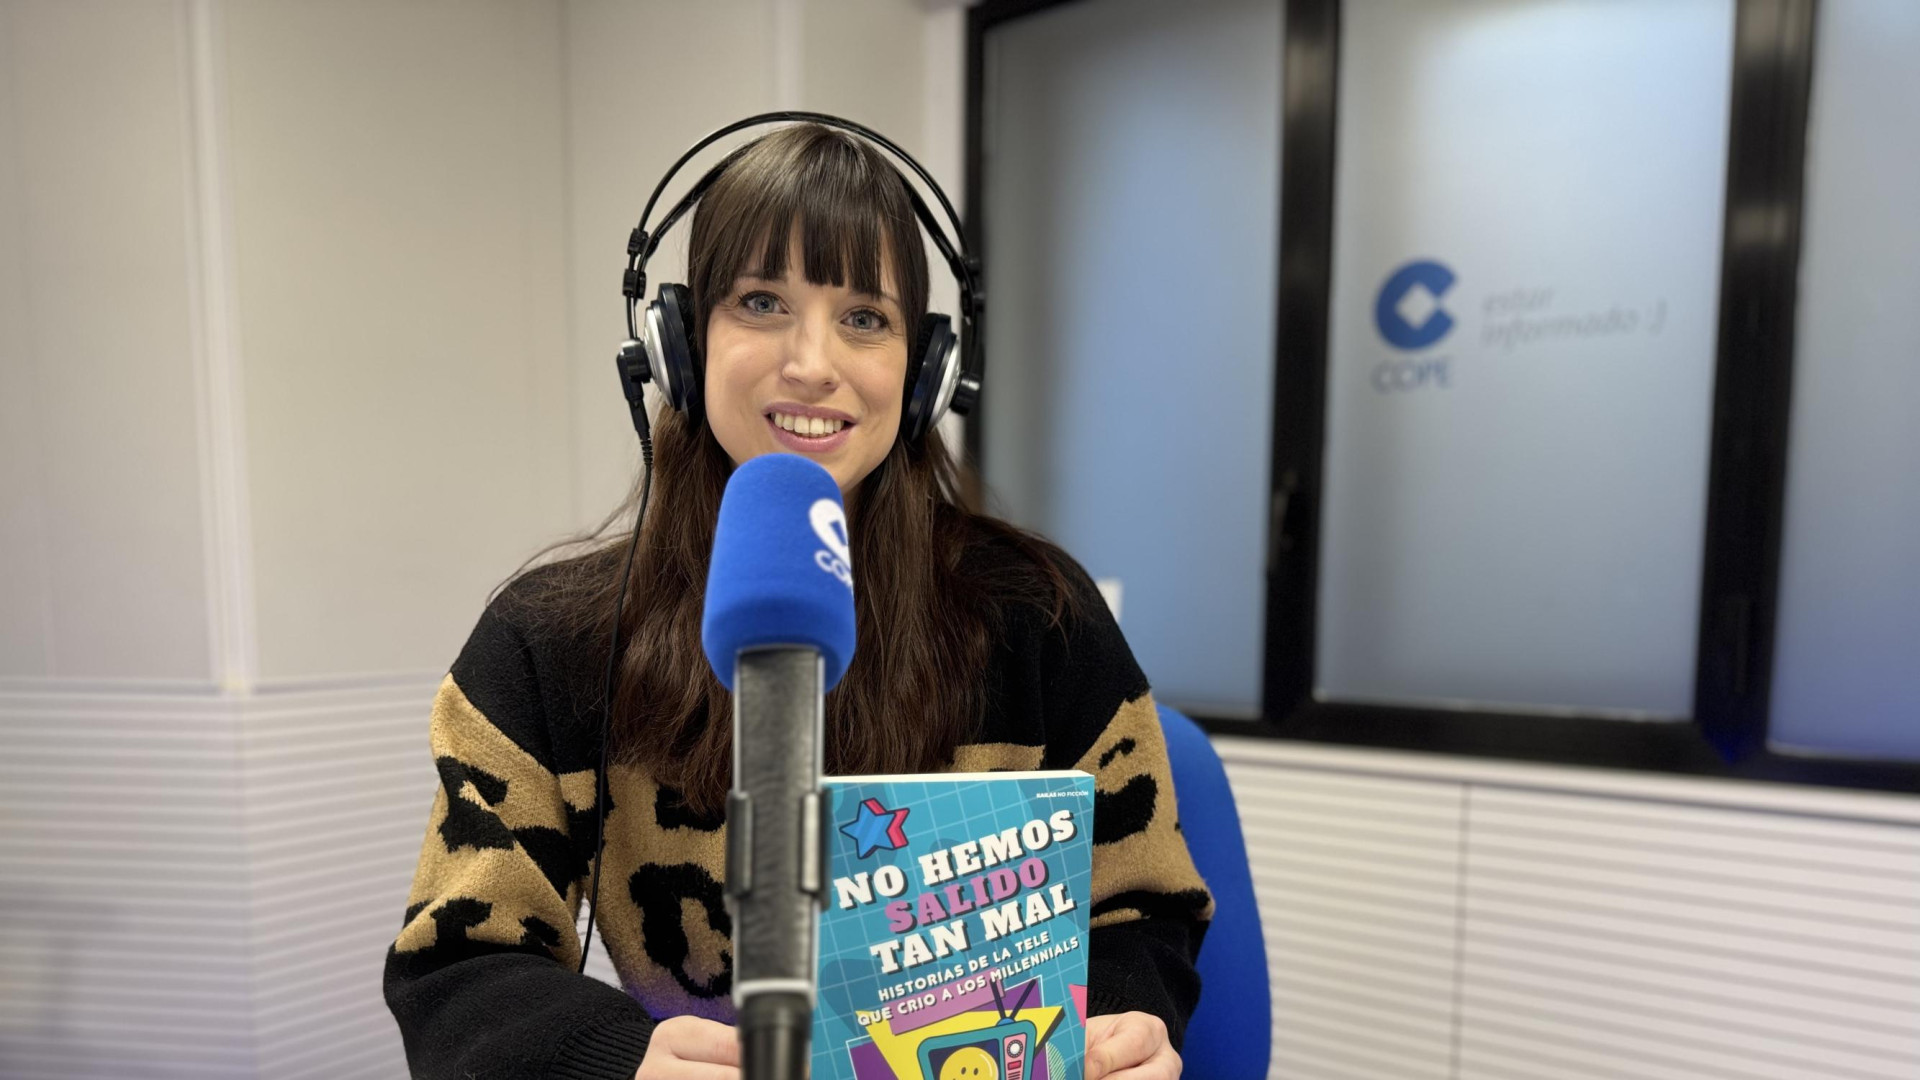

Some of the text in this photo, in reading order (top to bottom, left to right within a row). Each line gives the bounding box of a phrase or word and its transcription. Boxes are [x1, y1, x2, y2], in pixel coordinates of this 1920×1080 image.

[833, 810, 1076, 909] NO HEMOS
[885, 858, 1048, 933] SALIDO
[870, 883, 1075, 974] TAN MAL
[878, 931, 1051, 1002] HISTORIAS DE LA TELE
[857, 936, 1080, 1026] QUE CRIO A LOS MILLENNIALS
